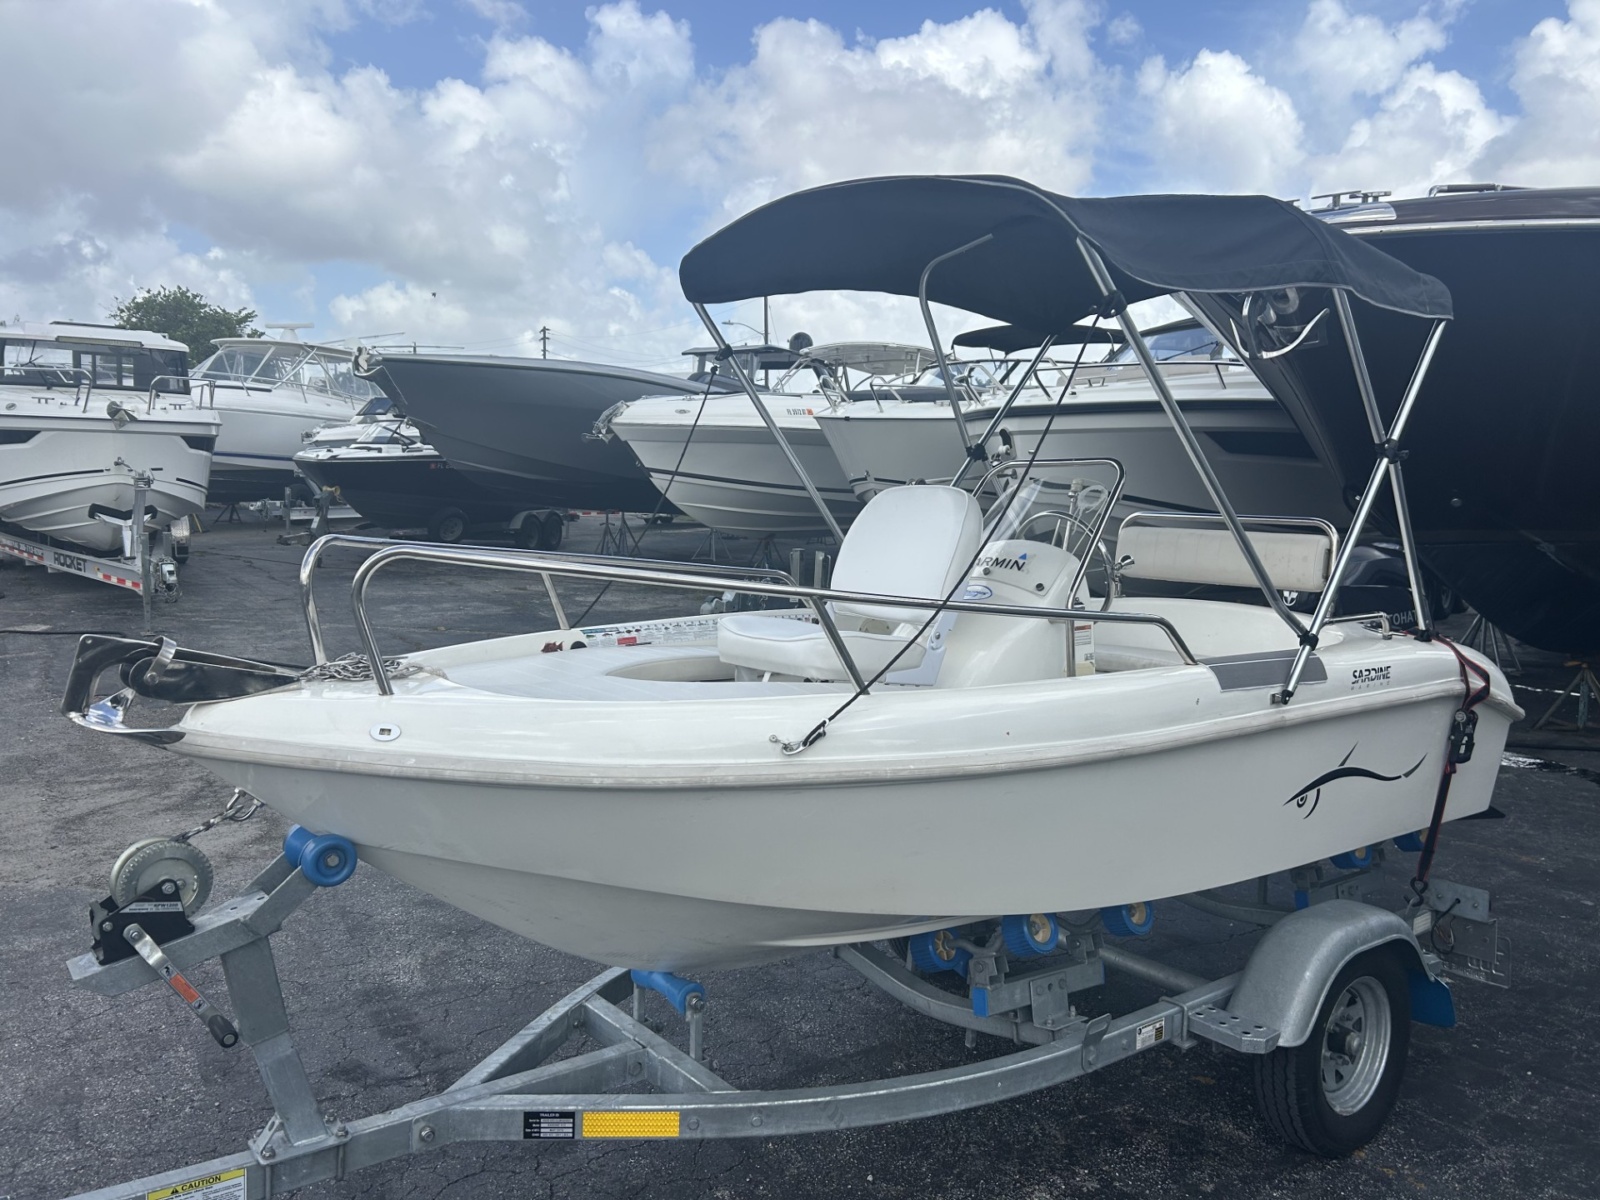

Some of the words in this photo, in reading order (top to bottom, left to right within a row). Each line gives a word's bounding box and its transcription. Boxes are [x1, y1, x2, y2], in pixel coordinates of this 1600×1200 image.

[53, 551, 88, 573] ROCKET
[1351, 665, 1392, 685] SARDINE
[181, 1175, 222, 1191] CAUTION
